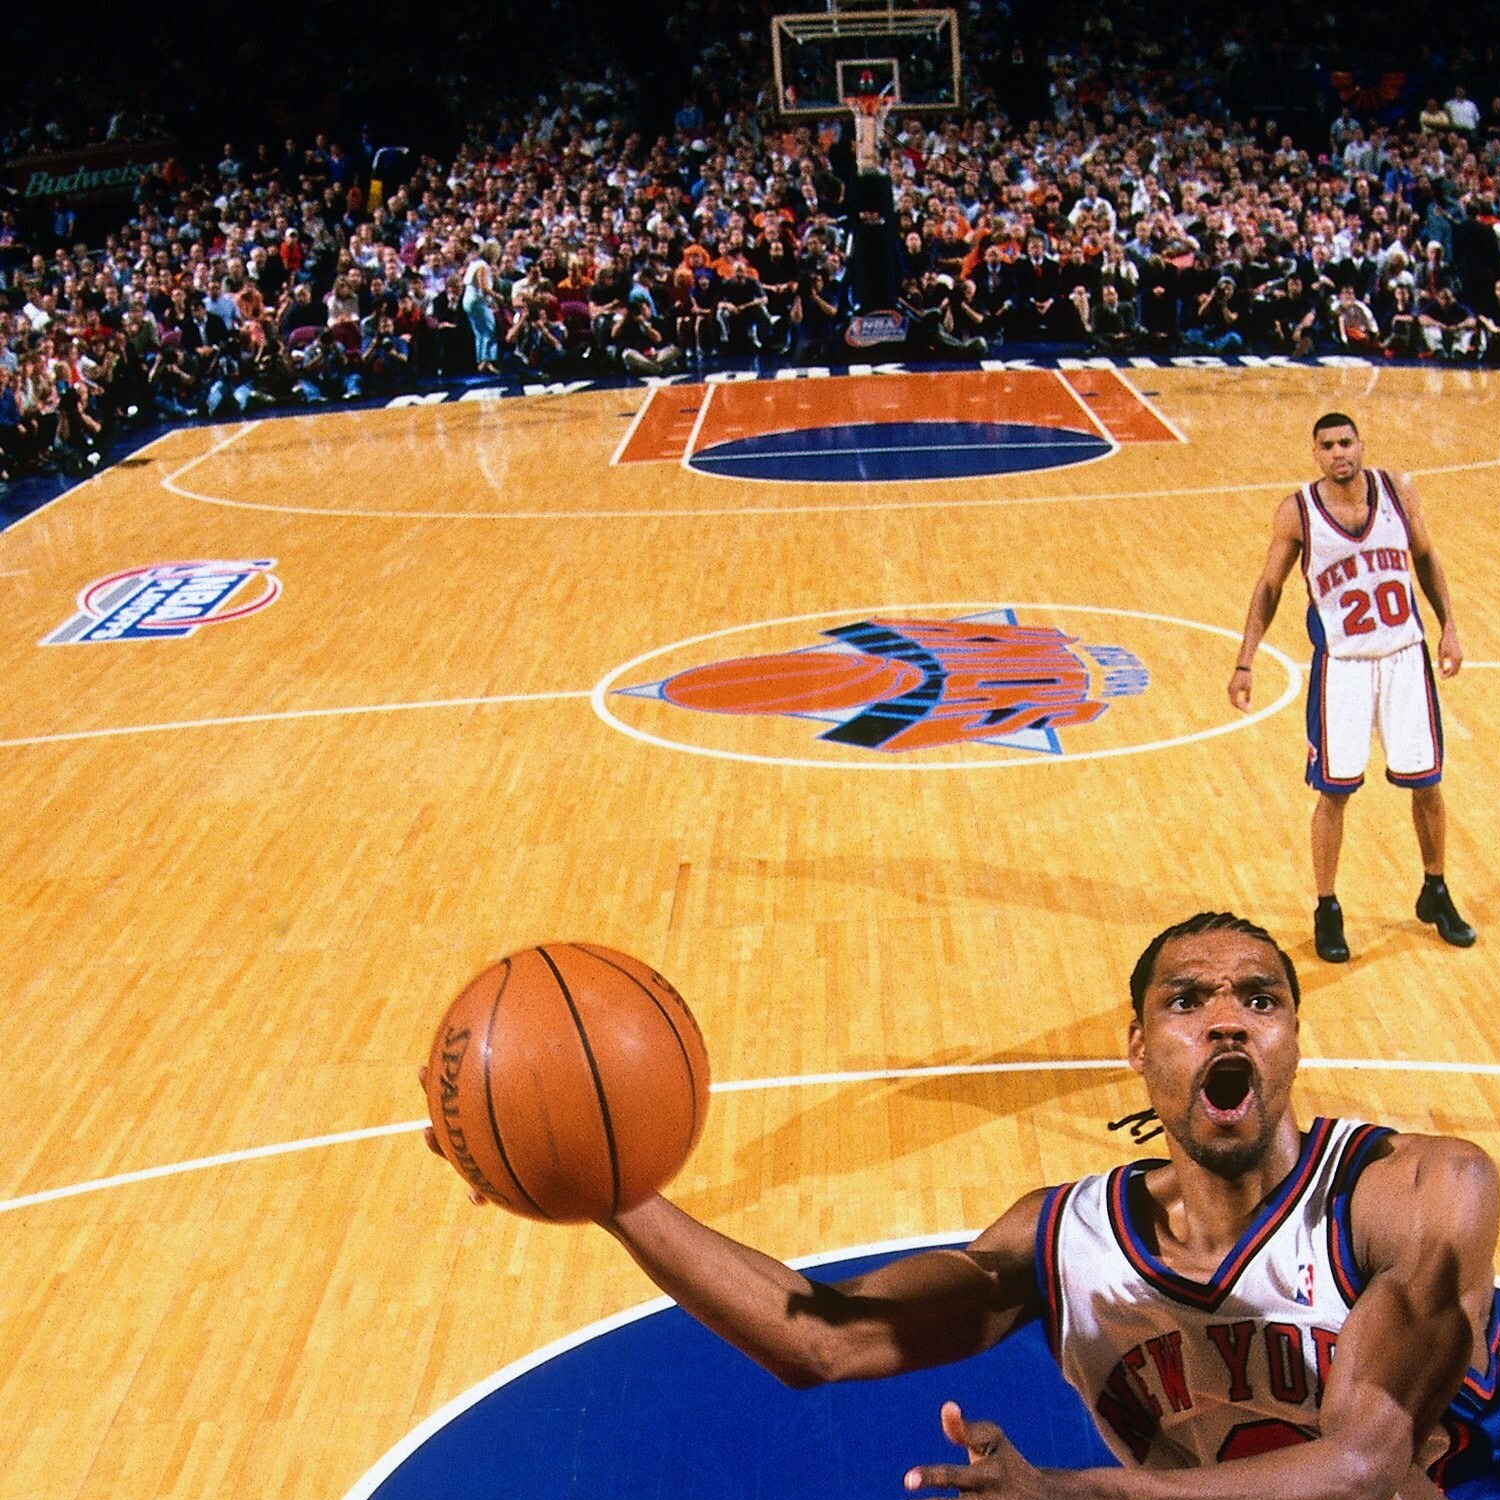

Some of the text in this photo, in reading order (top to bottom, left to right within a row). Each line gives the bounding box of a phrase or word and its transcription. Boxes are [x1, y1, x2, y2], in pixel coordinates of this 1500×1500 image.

[24, 160, 153, 198] Budweis
[385, 354, 1374, 409] NEW YORK KNICKS
[140, 574, 240, 624] NBA
[1316, 554, 1358, 598] NEW
[1339, 579, 1411, 637] 20
[868, 617, 1111, 754] KNICKS
[439, 1026, 514, 1206] SPALDING
[1095, 1319, 1339, 1466] NEW YO
